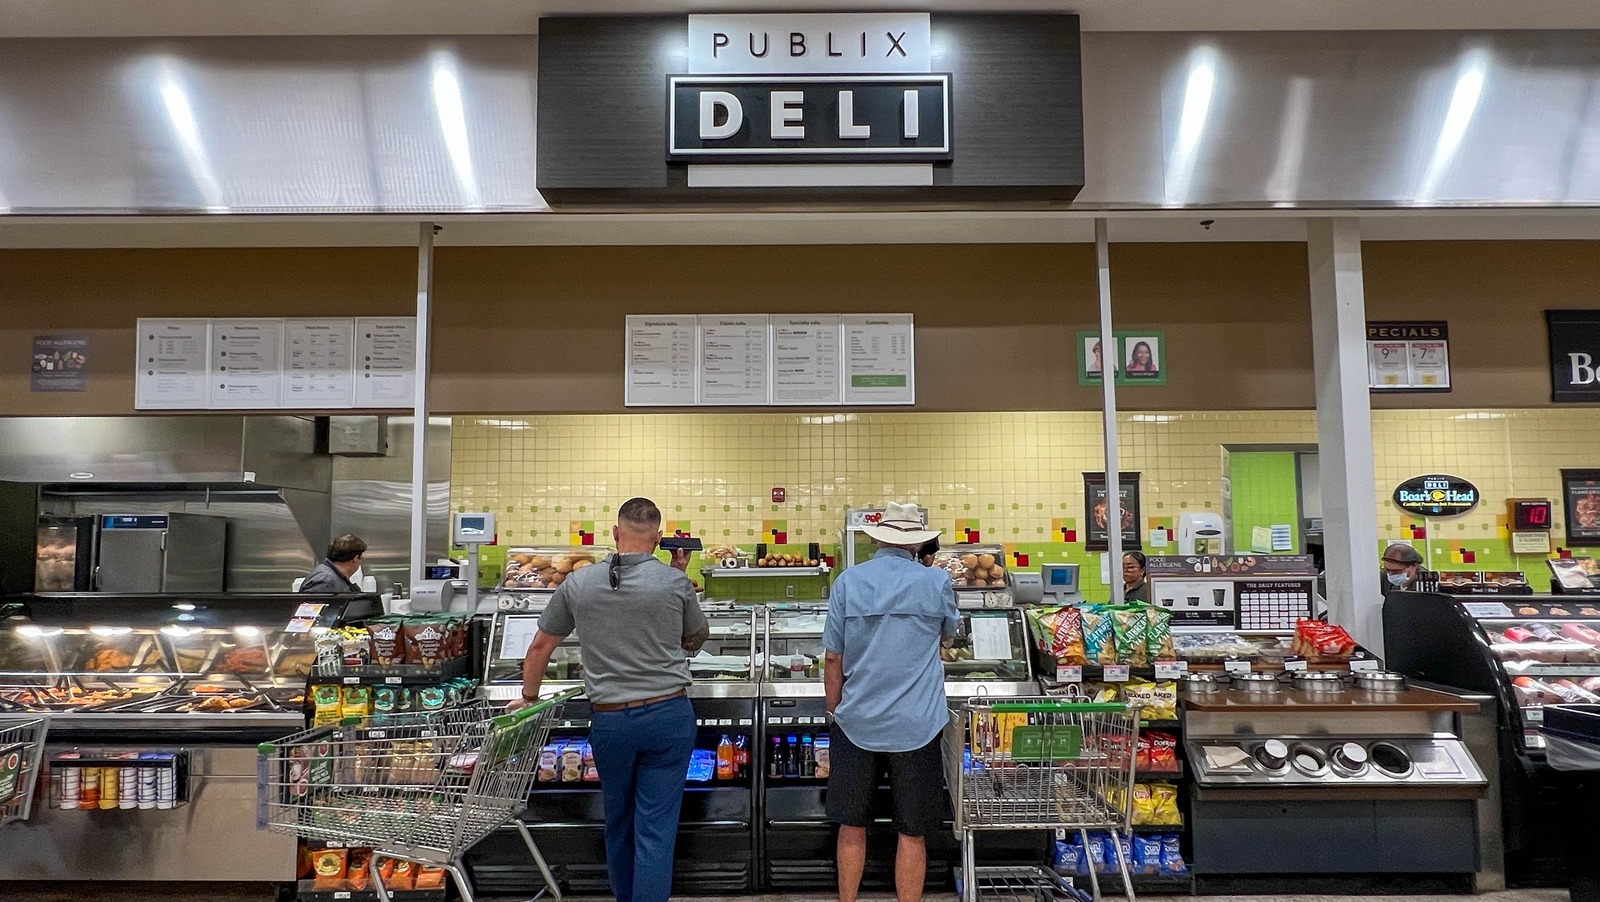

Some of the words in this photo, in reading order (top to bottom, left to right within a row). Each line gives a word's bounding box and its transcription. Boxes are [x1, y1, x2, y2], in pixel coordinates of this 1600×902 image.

[713, 32, 907, 57] PUBLIX
[699, 90, 919, 139] DELI
[1368, 327, 1440, 337] PECIALS
[1399, 490, 1431, 502] Boar's
[1445, 490, 1474, 502] Head
[1530, 507, 1547, 524] 10
[1052, 612, 1079, 647] FLATBREAD
[1086, 620, 1112, 645] FLATBRE
[1144, 844, 1161, 856] Sun
